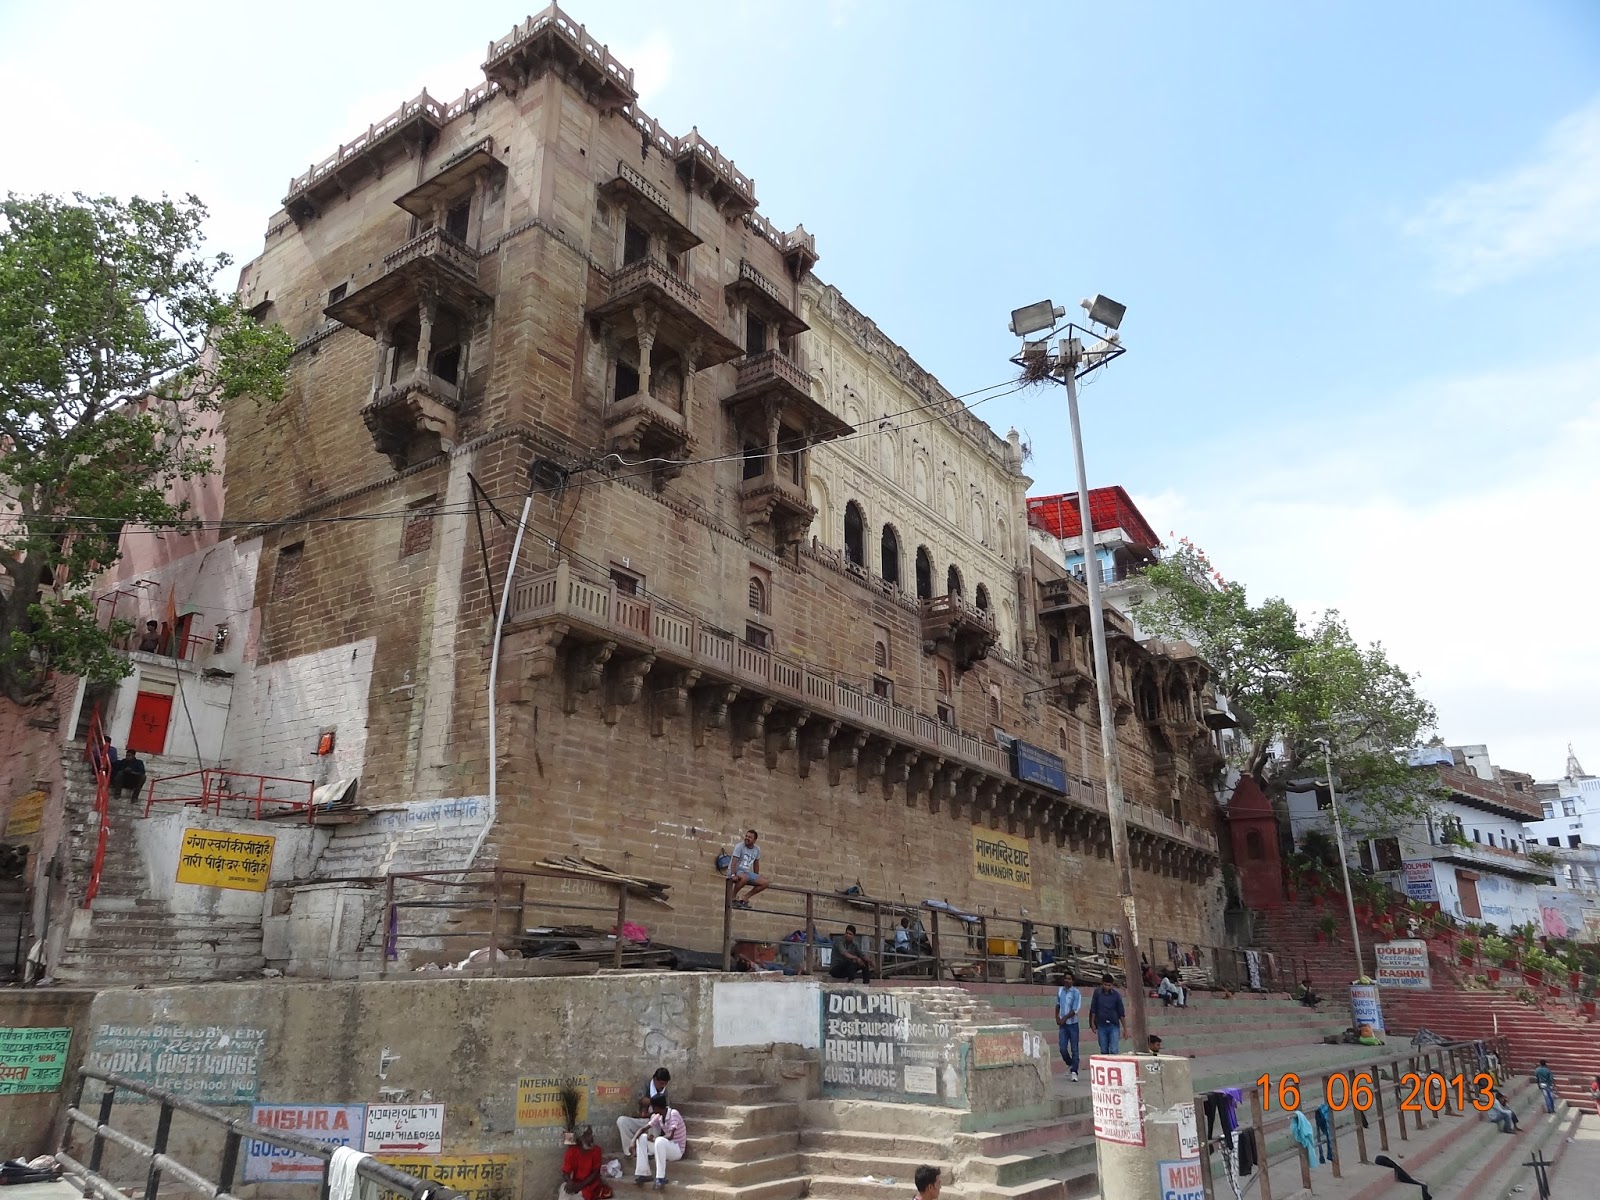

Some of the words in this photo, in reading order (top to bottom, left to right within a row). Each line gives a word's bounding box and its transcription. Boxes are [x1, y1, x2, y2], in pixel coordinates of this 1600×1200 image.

[1015, 869, 1030, 884] GHAT
[1376, 947, 1422, 955] DOLPHIN
[1379, 969, 1425, 978] RASHMI
[829, 993, 912, 1020] DOLPHIN
[825, 1038, 894, 1065] RASHMI
[824, 1066, 856, 1085] GUEST
[859, 1069, 897, 1088] HOUSE
[1090, 1064, 1123, 1087] OGA
[256, 1109, 350, 1131] MISHRA
[518, 1109, 549, 1119] INDIAN
